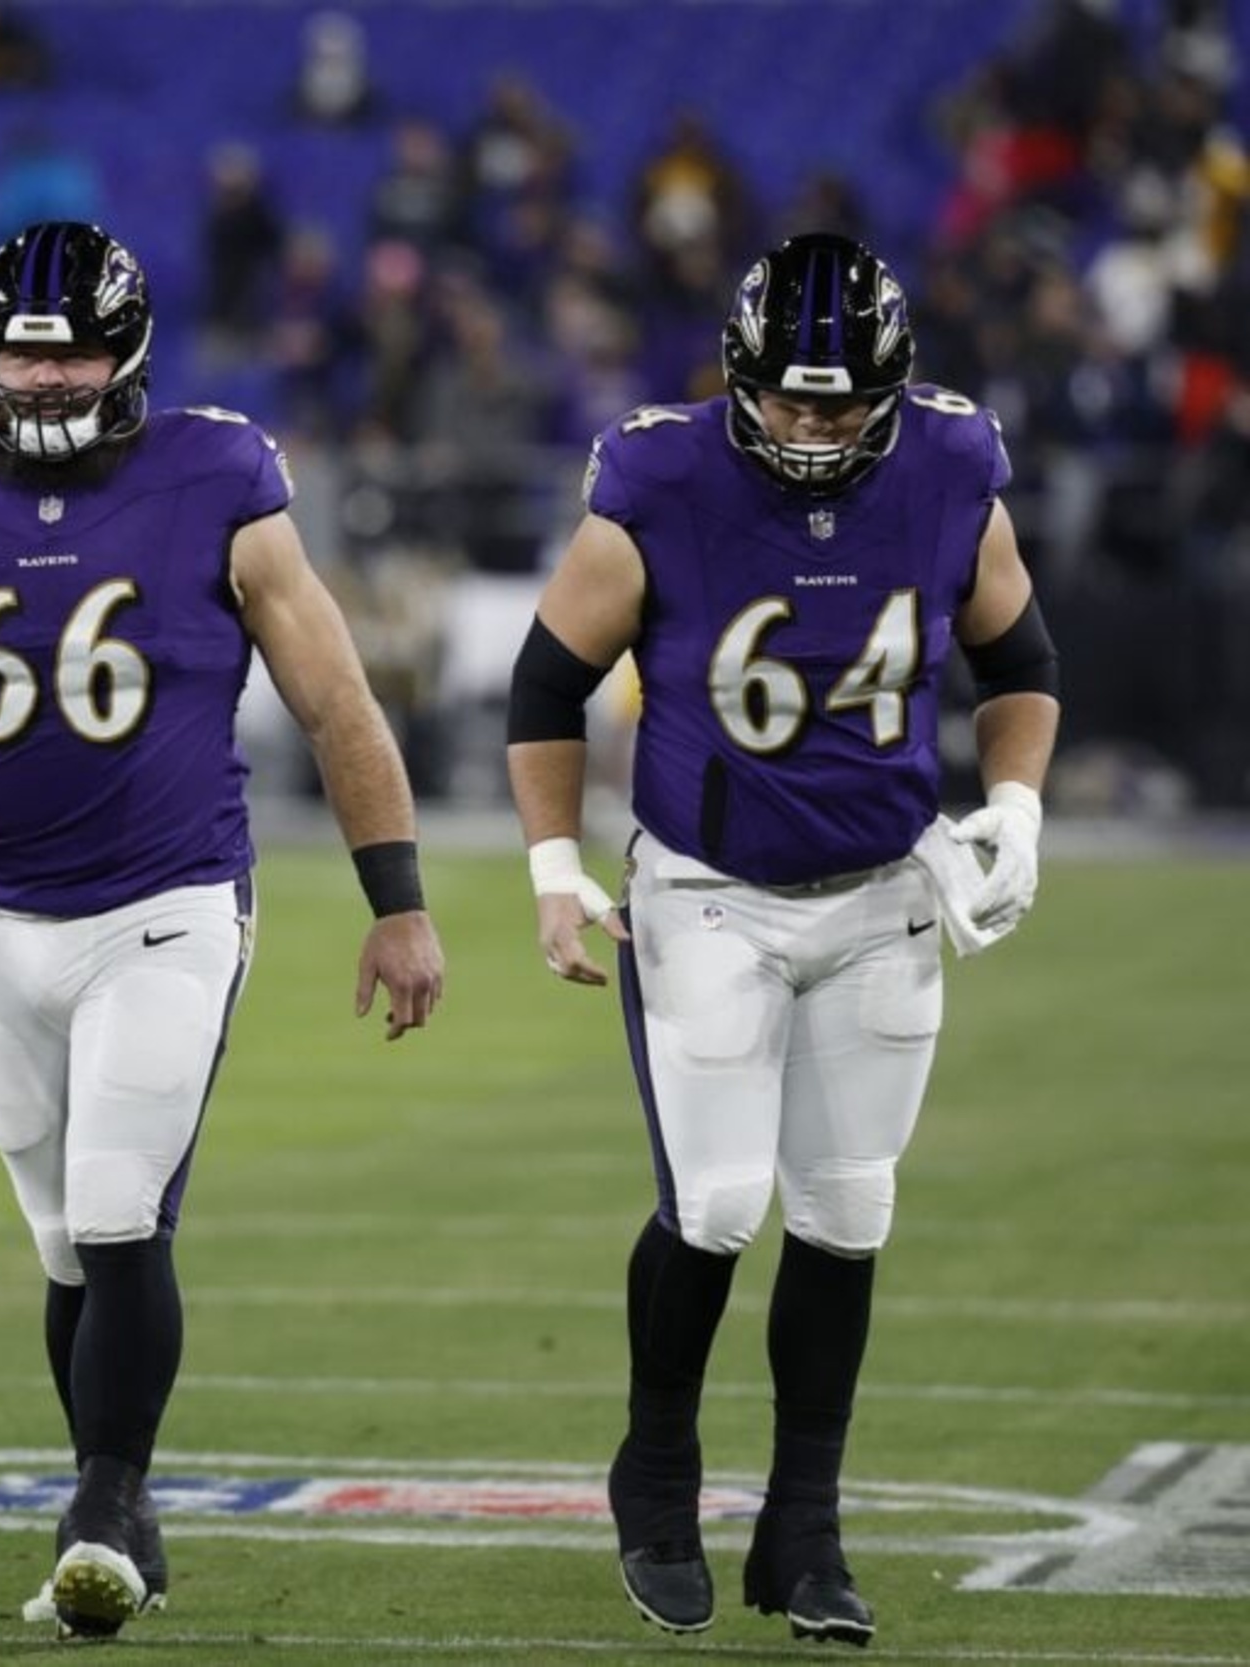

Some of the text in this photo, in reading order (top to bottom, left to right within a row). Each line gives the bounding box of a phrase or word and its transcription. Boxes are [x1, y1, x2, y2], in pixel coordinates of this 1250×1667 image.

[16, 554, 78, 567] RAVENS
[794, 575, 857, 586] RAVENS
[708, 587, 919, 753] 64
